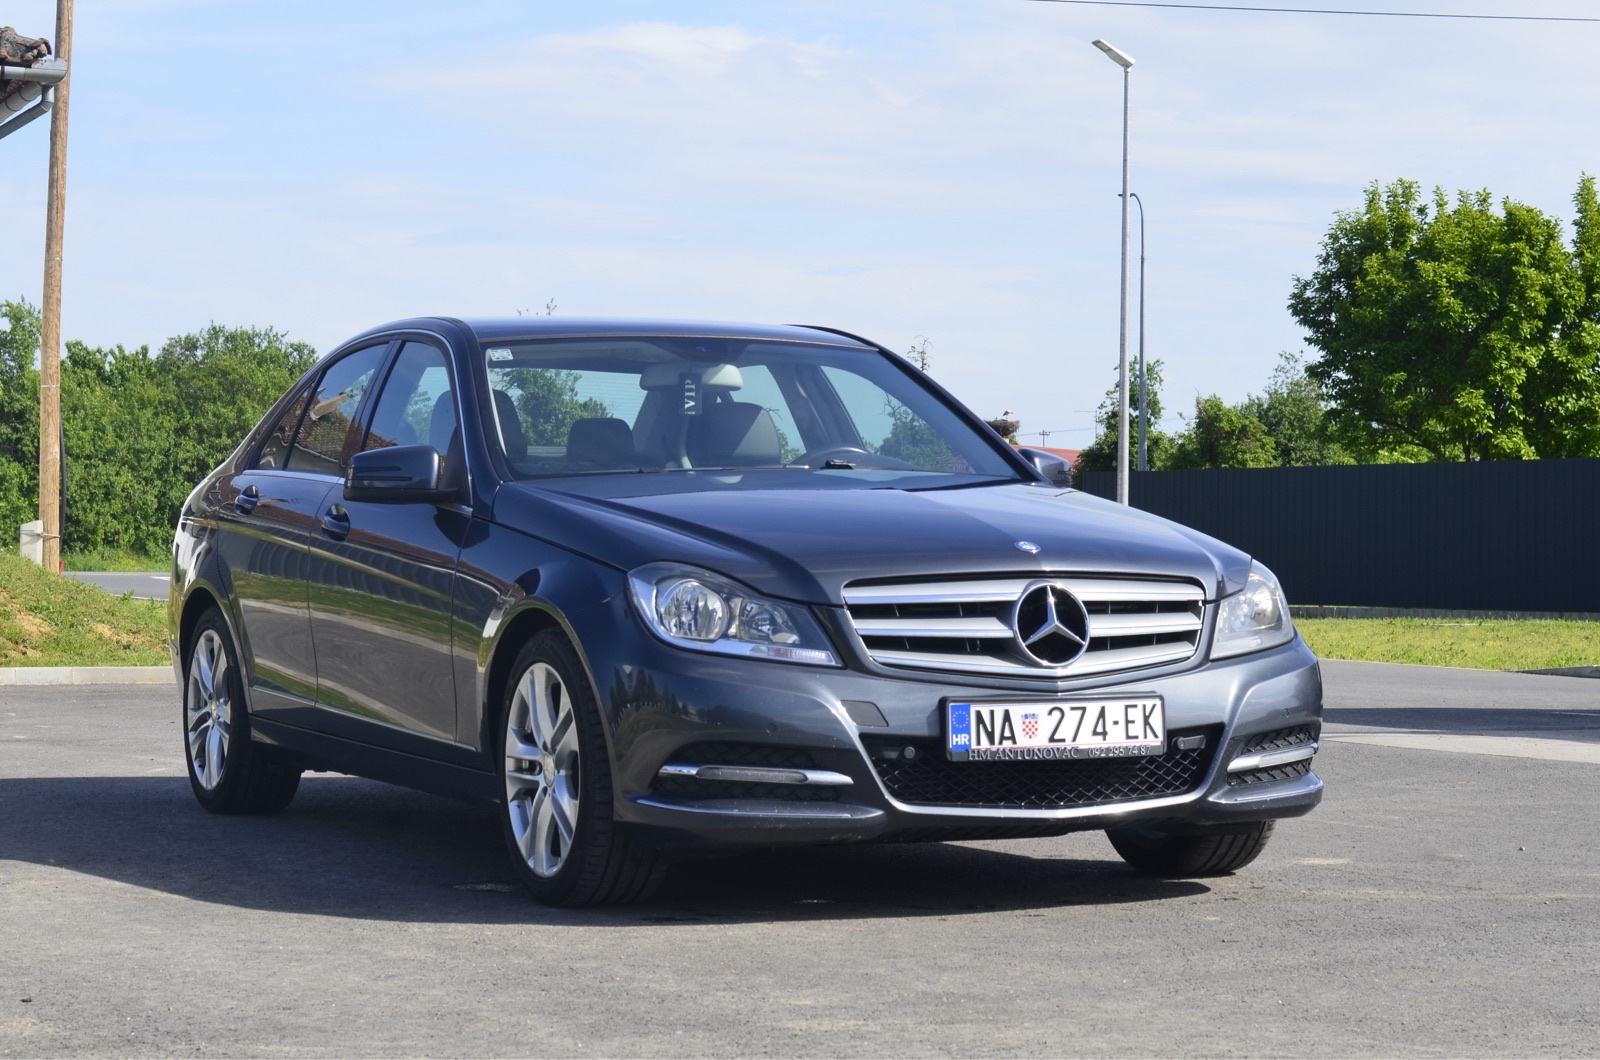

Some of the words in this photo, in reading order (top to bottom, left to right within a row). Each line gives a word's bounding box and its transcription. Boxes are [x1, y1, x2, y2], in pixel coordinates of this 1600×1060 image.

[684, 378, 696, 409] VIP
[975, 709, 1018, 746] NA
[1047, 703, 1160, 743] 274-EK
[952, 733, 970, 745] HR
[968, 749, 991, 761] HM
[1088, 747, 1106, 758] 092
